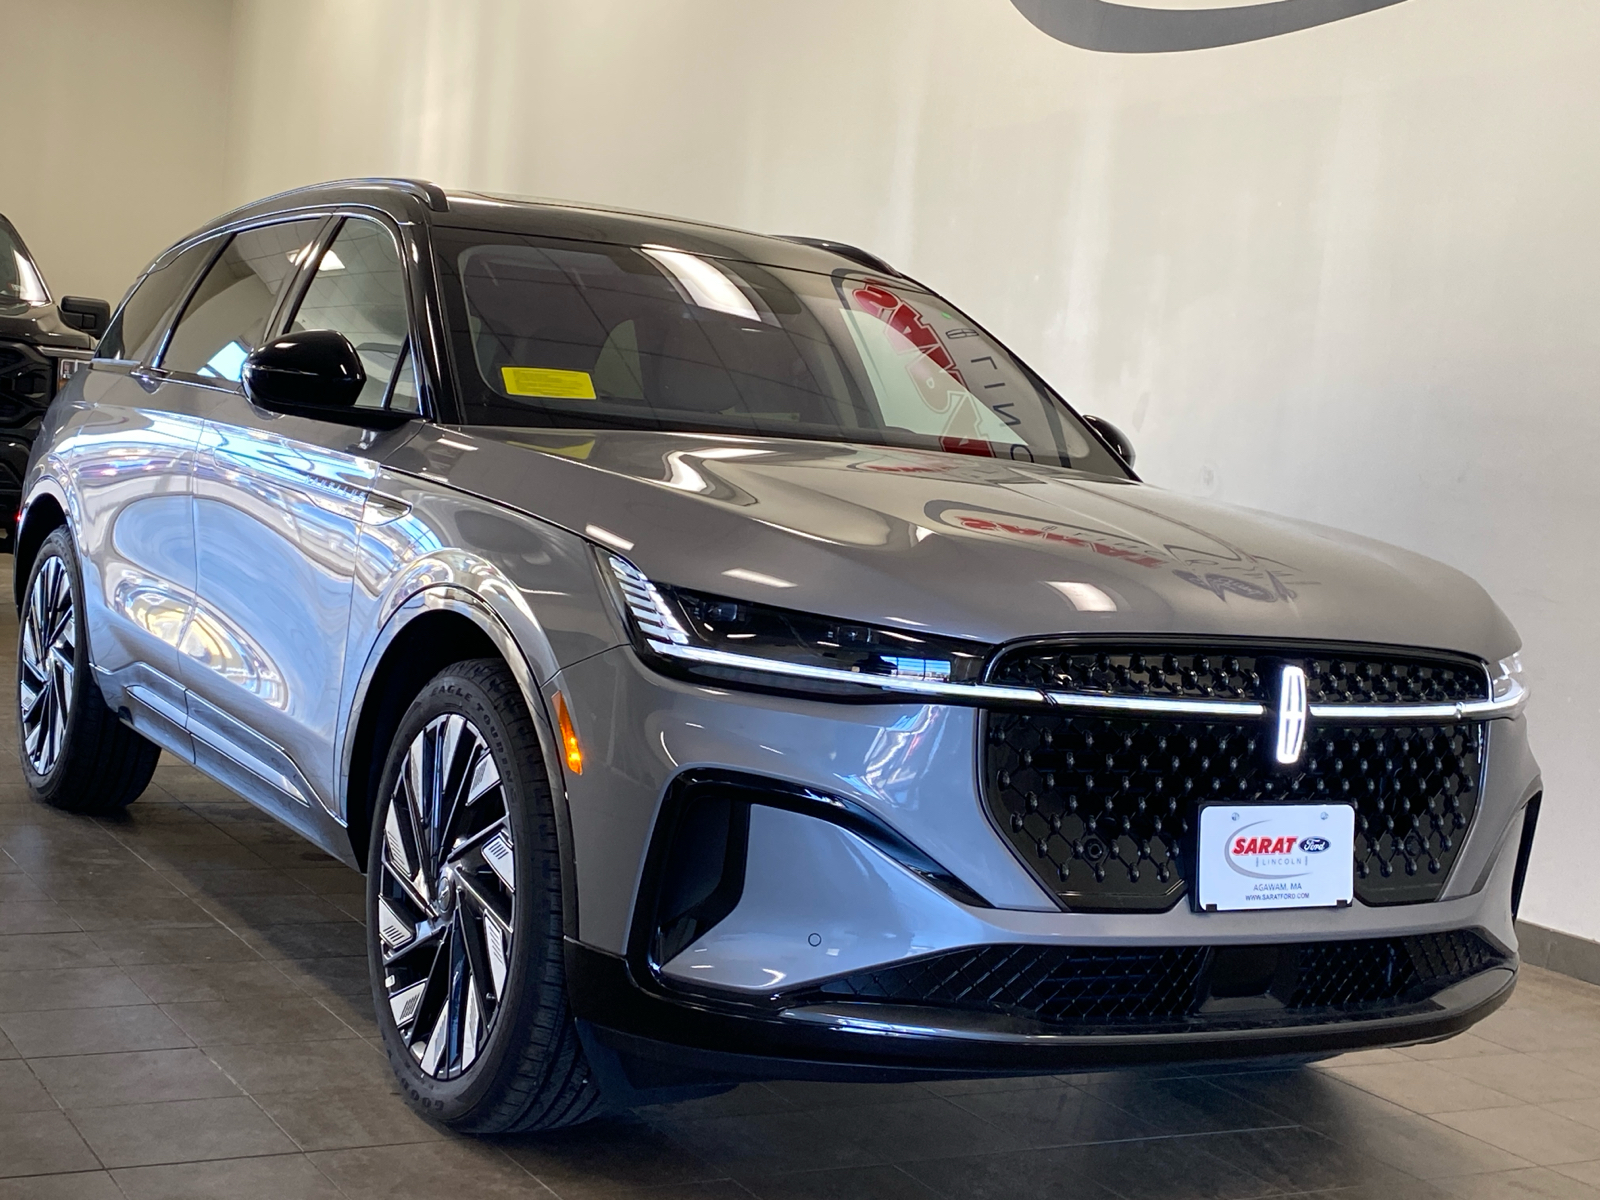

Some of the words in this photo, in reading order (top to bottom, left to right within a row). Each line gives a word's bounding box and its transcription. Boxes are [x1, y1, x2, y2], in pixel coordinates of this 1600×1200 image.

[430, 684, 473, 702] EAGLE
[1232, 836, 1299, 855] SARAT
[1303, 837, 1327, 852] Ford
[1261, 858, 1302, 866] LINCOLN
[1253, 883, 1289, 891] AGAWAM,
[1290, 882, 1302, 890] MA
[1245, 893, 1310, 901] WWW.SARATFORD.COM
